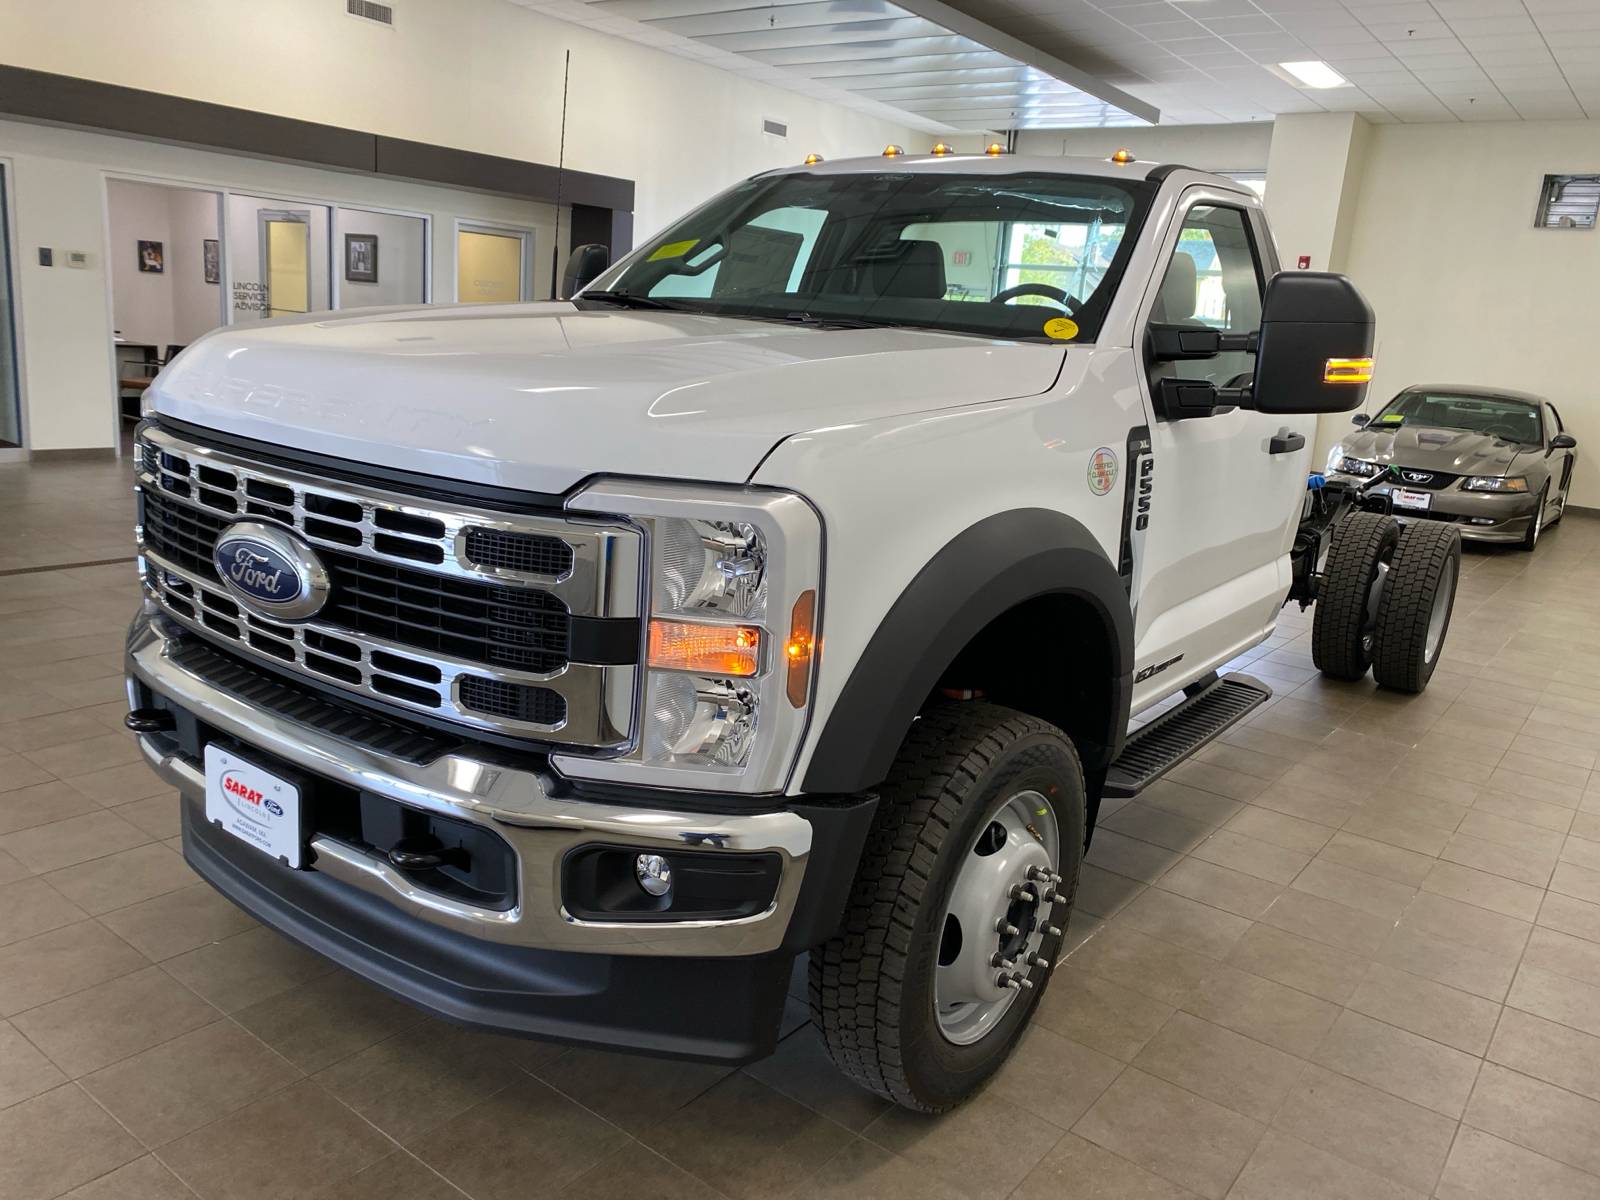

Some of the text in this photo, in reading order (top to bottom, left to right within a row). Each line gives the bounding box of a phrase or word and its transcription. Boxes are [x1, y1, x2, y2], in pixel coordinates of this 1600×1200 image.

[953, 251, 968, 264] EXIT
[232, 281, 269, 291] LINCOLN
[233, 291, 267, 301] SERVICE
[234, 301, 272, 311] ADVISOR
[1139, 440, 1150, 448] XL
[1094, 462, 1113, 470] CERTIFIED
[1091, 469, 1115, 478] CLEAN IDLE
[1135, 458, 1154, 531] F550
[230, 547, 282, 594] Ford
[224, 777, 282, 816] SARAT Ford
[241, 802, 267, 817] LINCOLN
